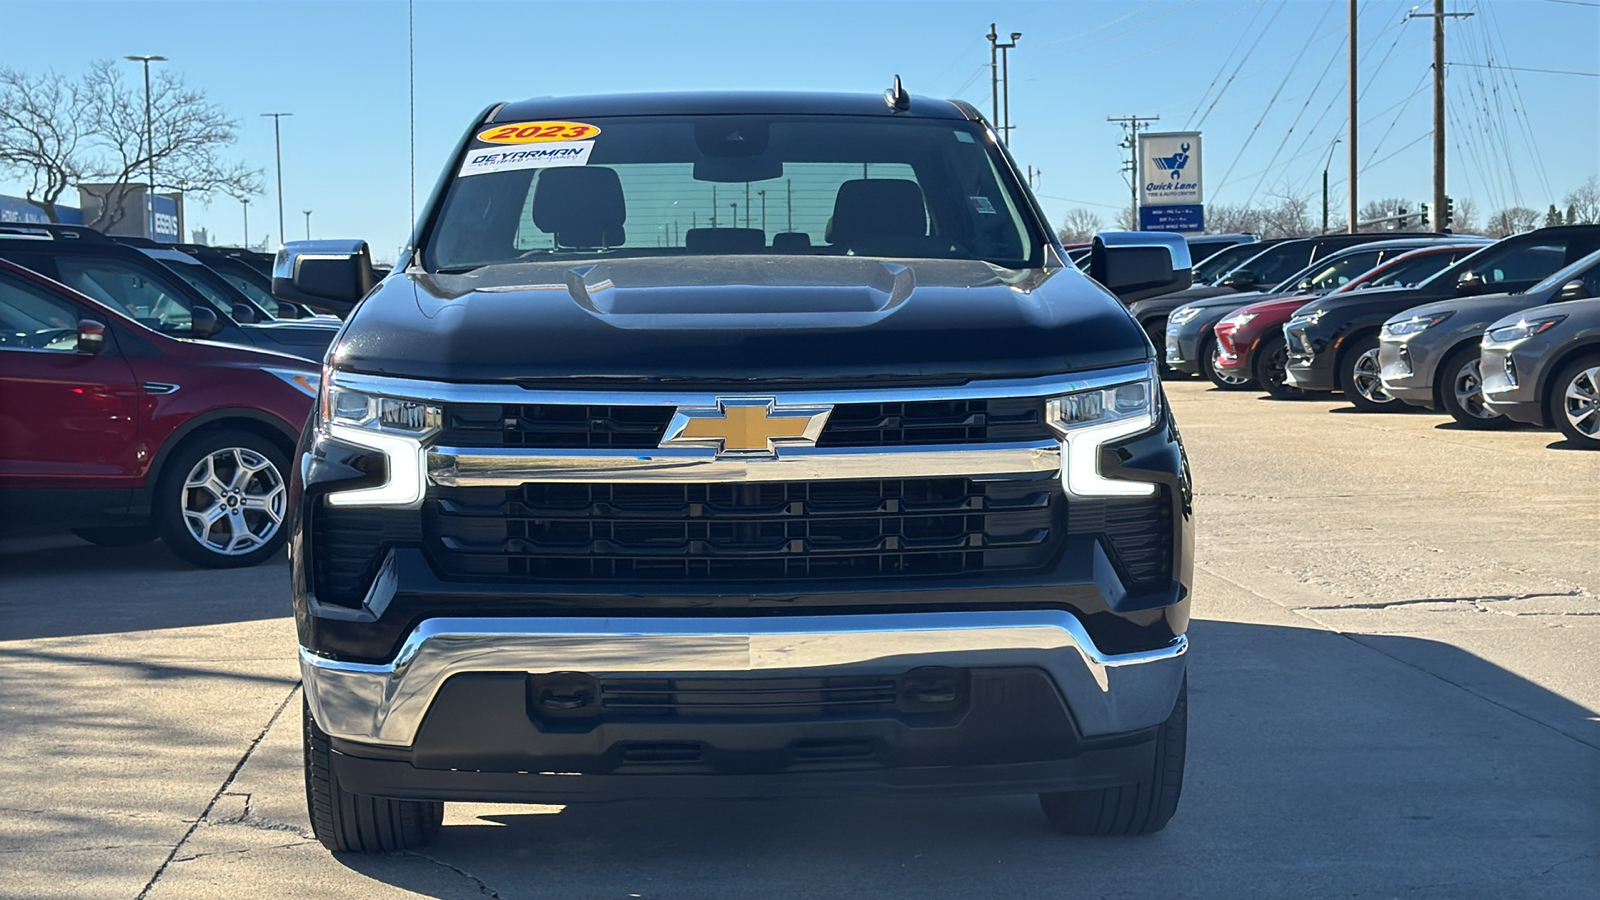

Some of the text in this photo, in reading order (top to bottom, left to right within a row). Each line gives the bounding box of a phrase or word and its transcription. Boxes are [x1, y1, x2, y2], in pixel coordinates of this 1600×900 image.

[488, 126, 590, 140] 2023
[472, 148, 584, 163] DEYARMAN
[478, 158, 524, 167] CERTIFIED
[1146, 182, 1197, 192] Quick Lane
